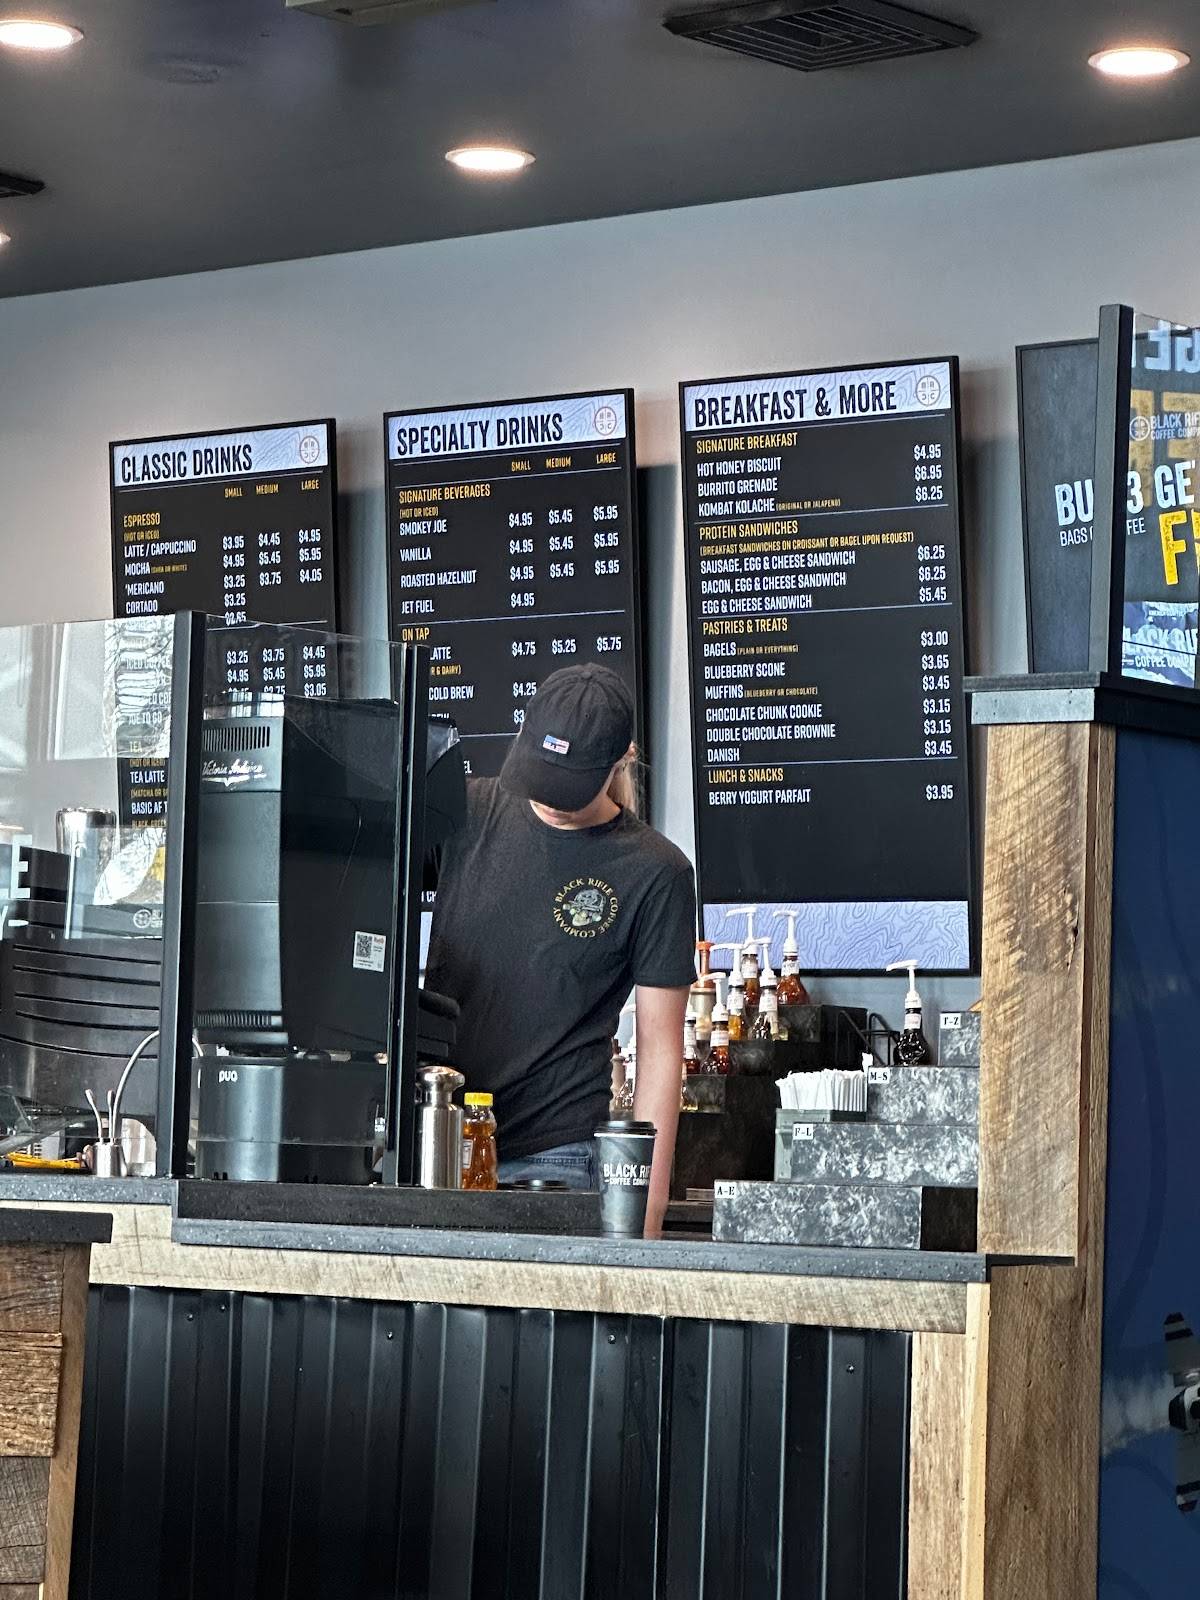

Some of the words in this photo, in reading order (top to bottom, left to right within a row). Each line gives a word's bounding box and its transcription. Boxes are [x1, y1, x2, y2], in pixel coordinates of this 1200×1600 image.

[694, 389, 807, 427] BREAKFAST
[815, 387, 832, 417] &
[839, 381, 897, 415] MORE
[1150, 413, 1182, 429] BLACK
[397, 420, 490, 456] SPECIALTY
[496, 413, 563, 447] DRINKS
[696, 436, 745, 454] SIGNATURE
[747, 432, 798, 450] BREAKFAST
[914, 444, 941, 461] $4.95
[121, 451, 187, 483] CLASSIC
[193, 444, 252, 476] DRINKS
[511, 460, 531, 472] SMALL
[546, 456, 572, 468] MEDIUM
[596, 452, 616, 464] LARGE
[697, 463, 714, 477] HOT
[716, 459, 745, 476] HONEY
[747, 456, 781, 473] BISCUIT
[914, 465, 942, 481] $6.95
[224, 487, 243, 498] SMALL
[256, 484, 279, 495] MEDIUM
[301, 479, 320, 491] LARGE
[399, 487, 442, 504] SIGNATURE
[444, 484, 491, 500] BEVERAGES
[698, 481, 735, 497] BURRITO
[737, 478, 778, 495] GRENADE
[915, 486, 943, 502] $6.25
[1055, 478, 1094, 527] BU
[1126, 470, 1144, 514] 3
[1154, 459, 1195, 509] GE
[413, 508, 421, 518] OR
[699, 501, 734, 518] KOMBAT
[735, 497, 775, 514] KOLACHE
[123, 512, 161, 528] ESPRESSO
[509, 512, 533, 528] $4.95
[549, 509, 573, 525] $5.45
[593, 505, 618, 521] $5.95
[399, 520, 432, 536] SMOKEY
[433, 519, 447, 534] JOE
[699, 524, 737, 540] PROTEIN
[739, 520, 798, 538] SANDWICHES
[1126, 517, 1146, 536] FEE
[222, 536, 245, 550] $3.95
[258, 532, 280, 547] $4.45
[298, 528, 321, 544] $4.95
[509, 539, 533, 555] $4.95
[549, 536, 573, 552] $5.45
[594, 533, 619, 549] $5.95
[700, 543, 737, 556] (BREAKFAST
[738, 541, 781, 554] SANDWICHES
[782, 540, 791, 551] ON
[792, 538, 829, 550] CROISSANT
[830, 537, 839, 548] OR
[840, 535, 861, 547] BAGEL
[862, 534, 880, 546] UPON
[881, 531, 914, 544] REQUEST)
[1059, 528, 1087, 547] BAGS
[124, 544, 145, 558] LATTE
[151, 540, 196, 556] CAPPUCCINO
[400, 547, 432, 562] VANILLA
[917, 545, 945, 561] $6.25
[223, 554, 245, 569] $4.95
[258, 551, 281, 565] $5.45
[299, 547, 322, 562] $5.95
[700, 557, 743, 575] SAUSAGE,
[744, 556, 762, 572] EGG
[763, 555, 770, 570] &
[771, 553, 806, 570] CHEESE
[807, 551, 856, 567] SANDWICH
[124, 562, 150, 576] MOCHA
[510, 566, 534, 582] $4.95
[550, 563, 574, 578] $5.45
[594, 560, 620, 576] $5.95
[918, 566, 946, 582] $6.25
[223, 574, 246, 589] $3.25
[259, 571, 281, 587] $3.75
[300, 568, 322, 583] $4.05
[401, 573, 436, 588] ROASTED
[436, 570, 477, 586] HAZELNUT
[701, 578, 733, 594] BACON,
[735, 577, 753, 592] EGG
[754, 576, 761, 591] &
[762, 574, 796, 590] CHEESE
[798, 572, 846, 588] SANDWICH
[224, 593, 246, 608] $3.25
[510, 592, 535, 608] $4.95
[919, 587, 947, 603] $5.45
[126, 599, 158, 614] CORTADO
[401, 601, 414, 615] JET
[415, 599, 434, 613] FUEL
[702, 599, 719, 614] EGG
[721, 598, 728, 613] &
[729, 596, 763, 612] CHEESE
[764, 595, 812, 611] SANDWICH
[402, 629, 413, 641] ON
[414, 627, 430, 640] TAP
[703, 619, 745, 635] PASTRIES
[746, 619, 753, 633] &
[755, 617, 788, 633] TREATS
[512, 642, 536, 657] $4.75
[552, 639, 577, 654] $5.25
[596, 636, 622, 652] $5.75
[920, 631, 948, 647] $3.00
[226, 650, 248, 665] $3.25
[262, 648, 284, 663] $3.75
[302, 645, 325, 660] $4.45
[430, 646, 451, 660] ATTE
[703, 642, 736, 657] BAGELS
[921, 654, 949, 671] $3.65
[1135, 655, 1167, 668] COFFEE
[227, 668, 249, 683] $4.95
[263, 666, 285, 681] $5.45
[303, 664, 326, 679] $5.95
[704, 663, 754, 680] BLUEBERRY
[755, 662, 786, 678] SCONE
[304, 683, 326, 698] $3.05
[513, 682, 537, 697] $4.25
[922, 675, 950, 691] $3.45
[428, 687, 449, 701] COLD
[450, 685, 474, 699] BREW
[705, 684, 744, 700] MUFFINS
[705, 706, 755, 723] CHOCOLATE
[757, 705, 788, 720] CHUNK
[789, 703, 822, 719] COOKIE
[923, 699, 951, 715] $3.15
[707, 727, 740, 743] DOUBLE
[742, 725, 792, 741] CHOCOLATE
[794, 723, 836, 739] BROWNIE
[924, 719, 951, 735] $3.15
[707, 748, 740, 762] DANISH
[924, 740, 952, 756] $3.45
[129, 771, 144, 784] TEA
[145, 770, 165, 783] LATTE
[708, 769, 738, 784] LUNCH
[739, 769, 746, 783] &
[748, 768, 784, 782] SNACKS
[709, 790, 738, 805] BERRY
[738, 789, 774, 804] YOGURT
[775, 788, 811, 803] PARFAIT
[926, 785, 953, 800] $3.95
[131, 801, 152, 814] BASIC
[153, 801, 162, 813] AF
[554, 878, 585, 903] BLACK
[588, 877, 614, 896] RIFLE
[553, 907, 596, 938] COMPANY
[598, 897, 619, 934] COFFEE
[870, 1072, 888, 1081] M-S
[794, 1127, 812, 1137] F-L
[603, 1163, 637, 1178] BLACK
[717, 1186, 735, 1196] A-E
